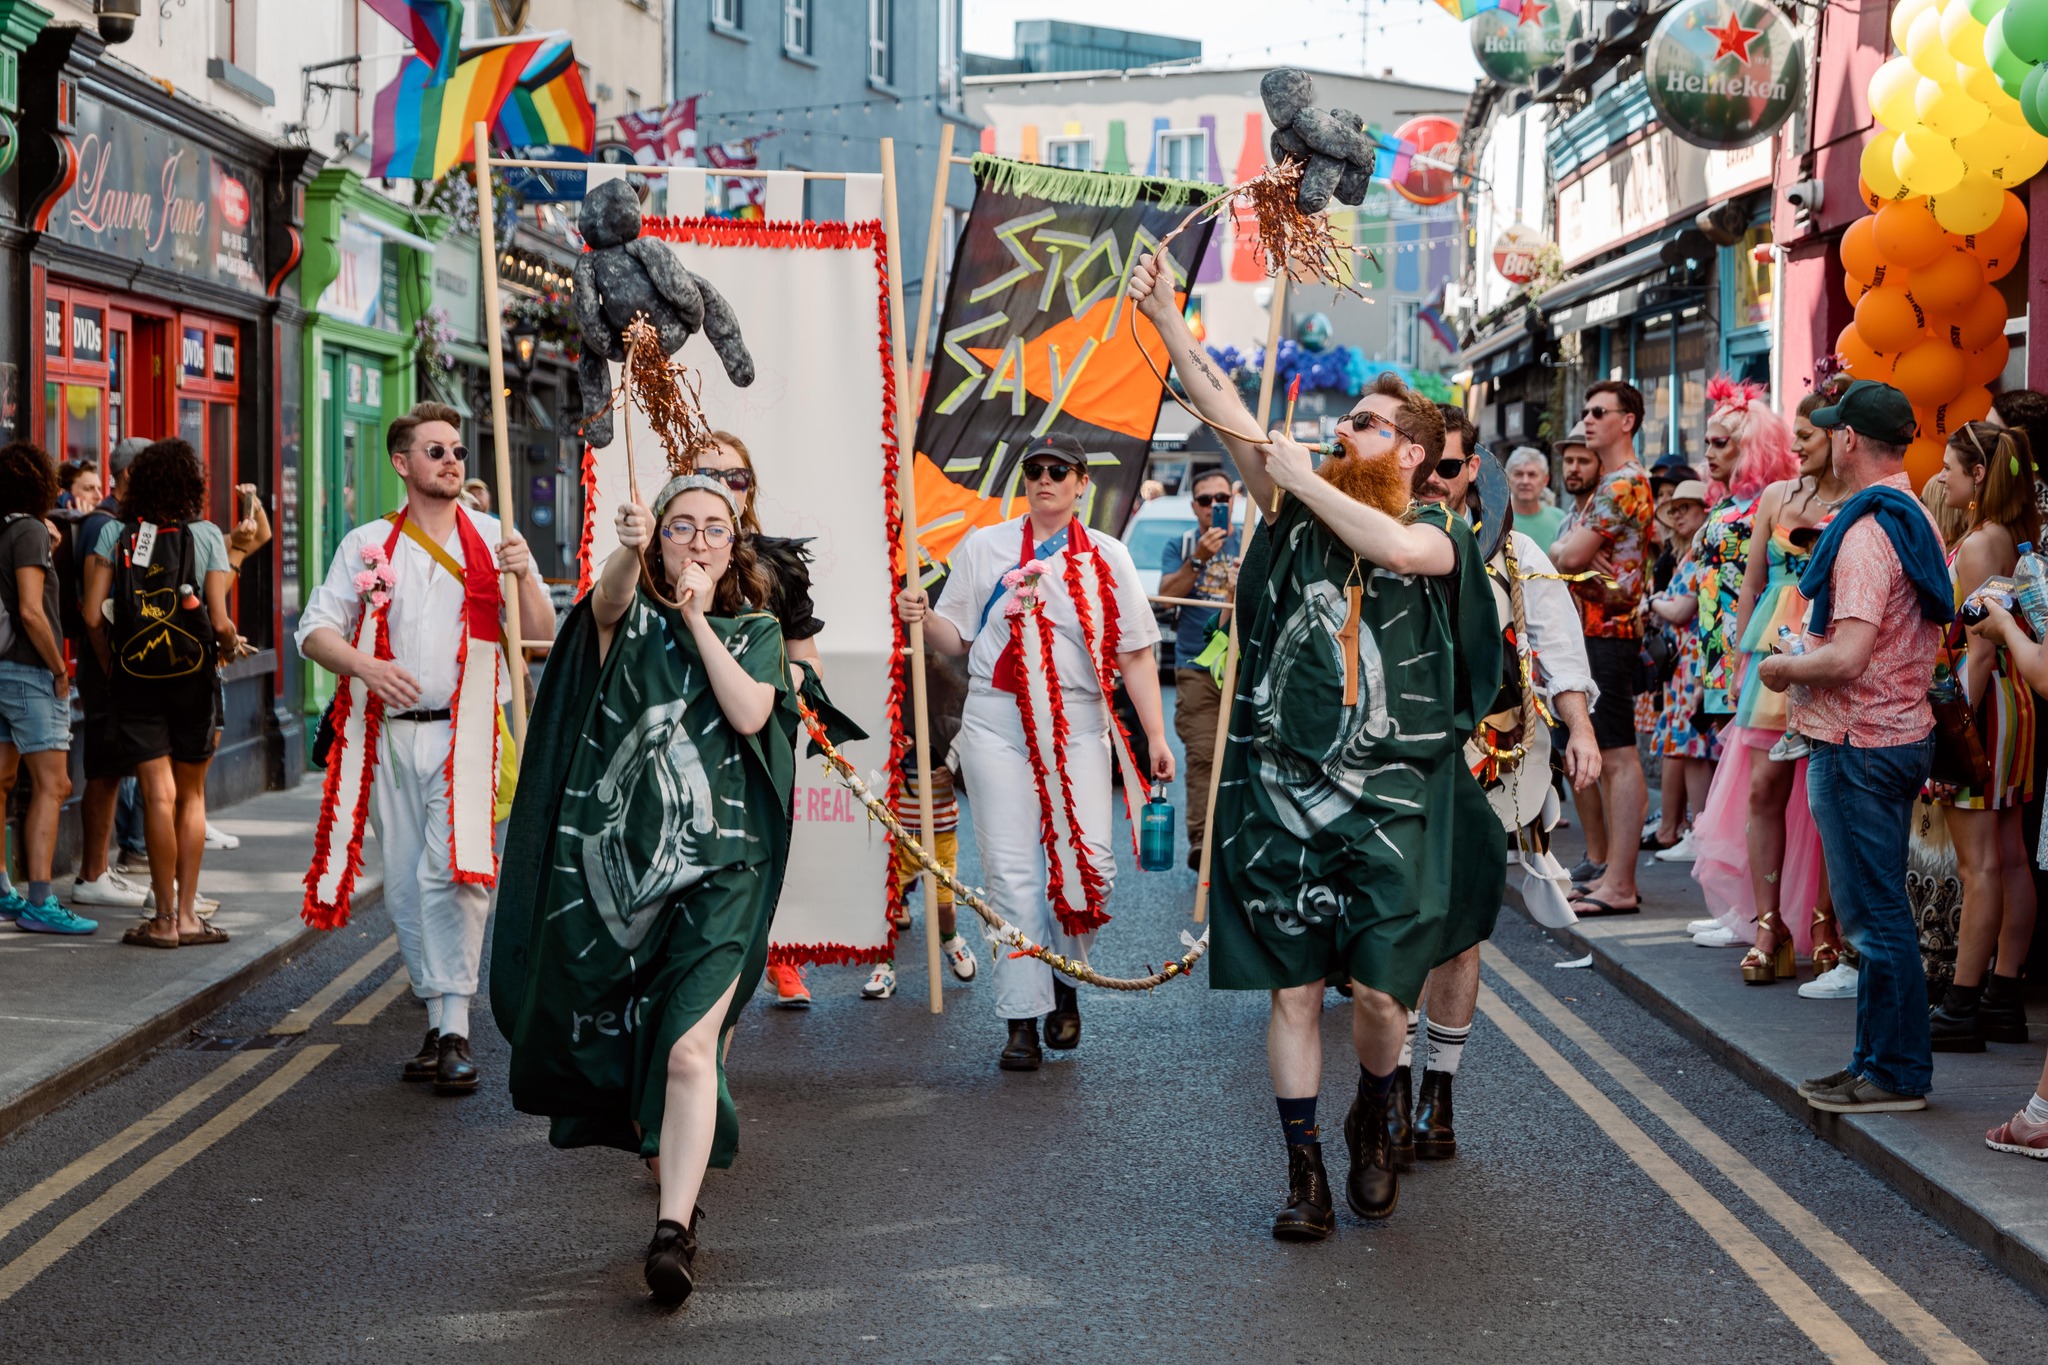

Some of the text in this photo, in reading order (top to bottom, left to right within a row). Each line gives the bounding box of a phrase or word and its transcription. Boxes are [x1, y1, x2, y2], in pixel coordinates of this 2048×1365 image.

[1485, 35, 1568, 54] Heinke
[1666, 69, 1787, 100] Heineken
[70, 133, 151, 233] Laura
[146, 149, 206, 252] Jane
[45, 311, 61, 348] ERIE
[73, 316, 101, 352] DVDs
[183, 337, 205, 370] DVDs
[935, 311, 1099, 439] SAY
[137, 532, 152, 557] 1368
[807, 787, 855, 823] REAL
